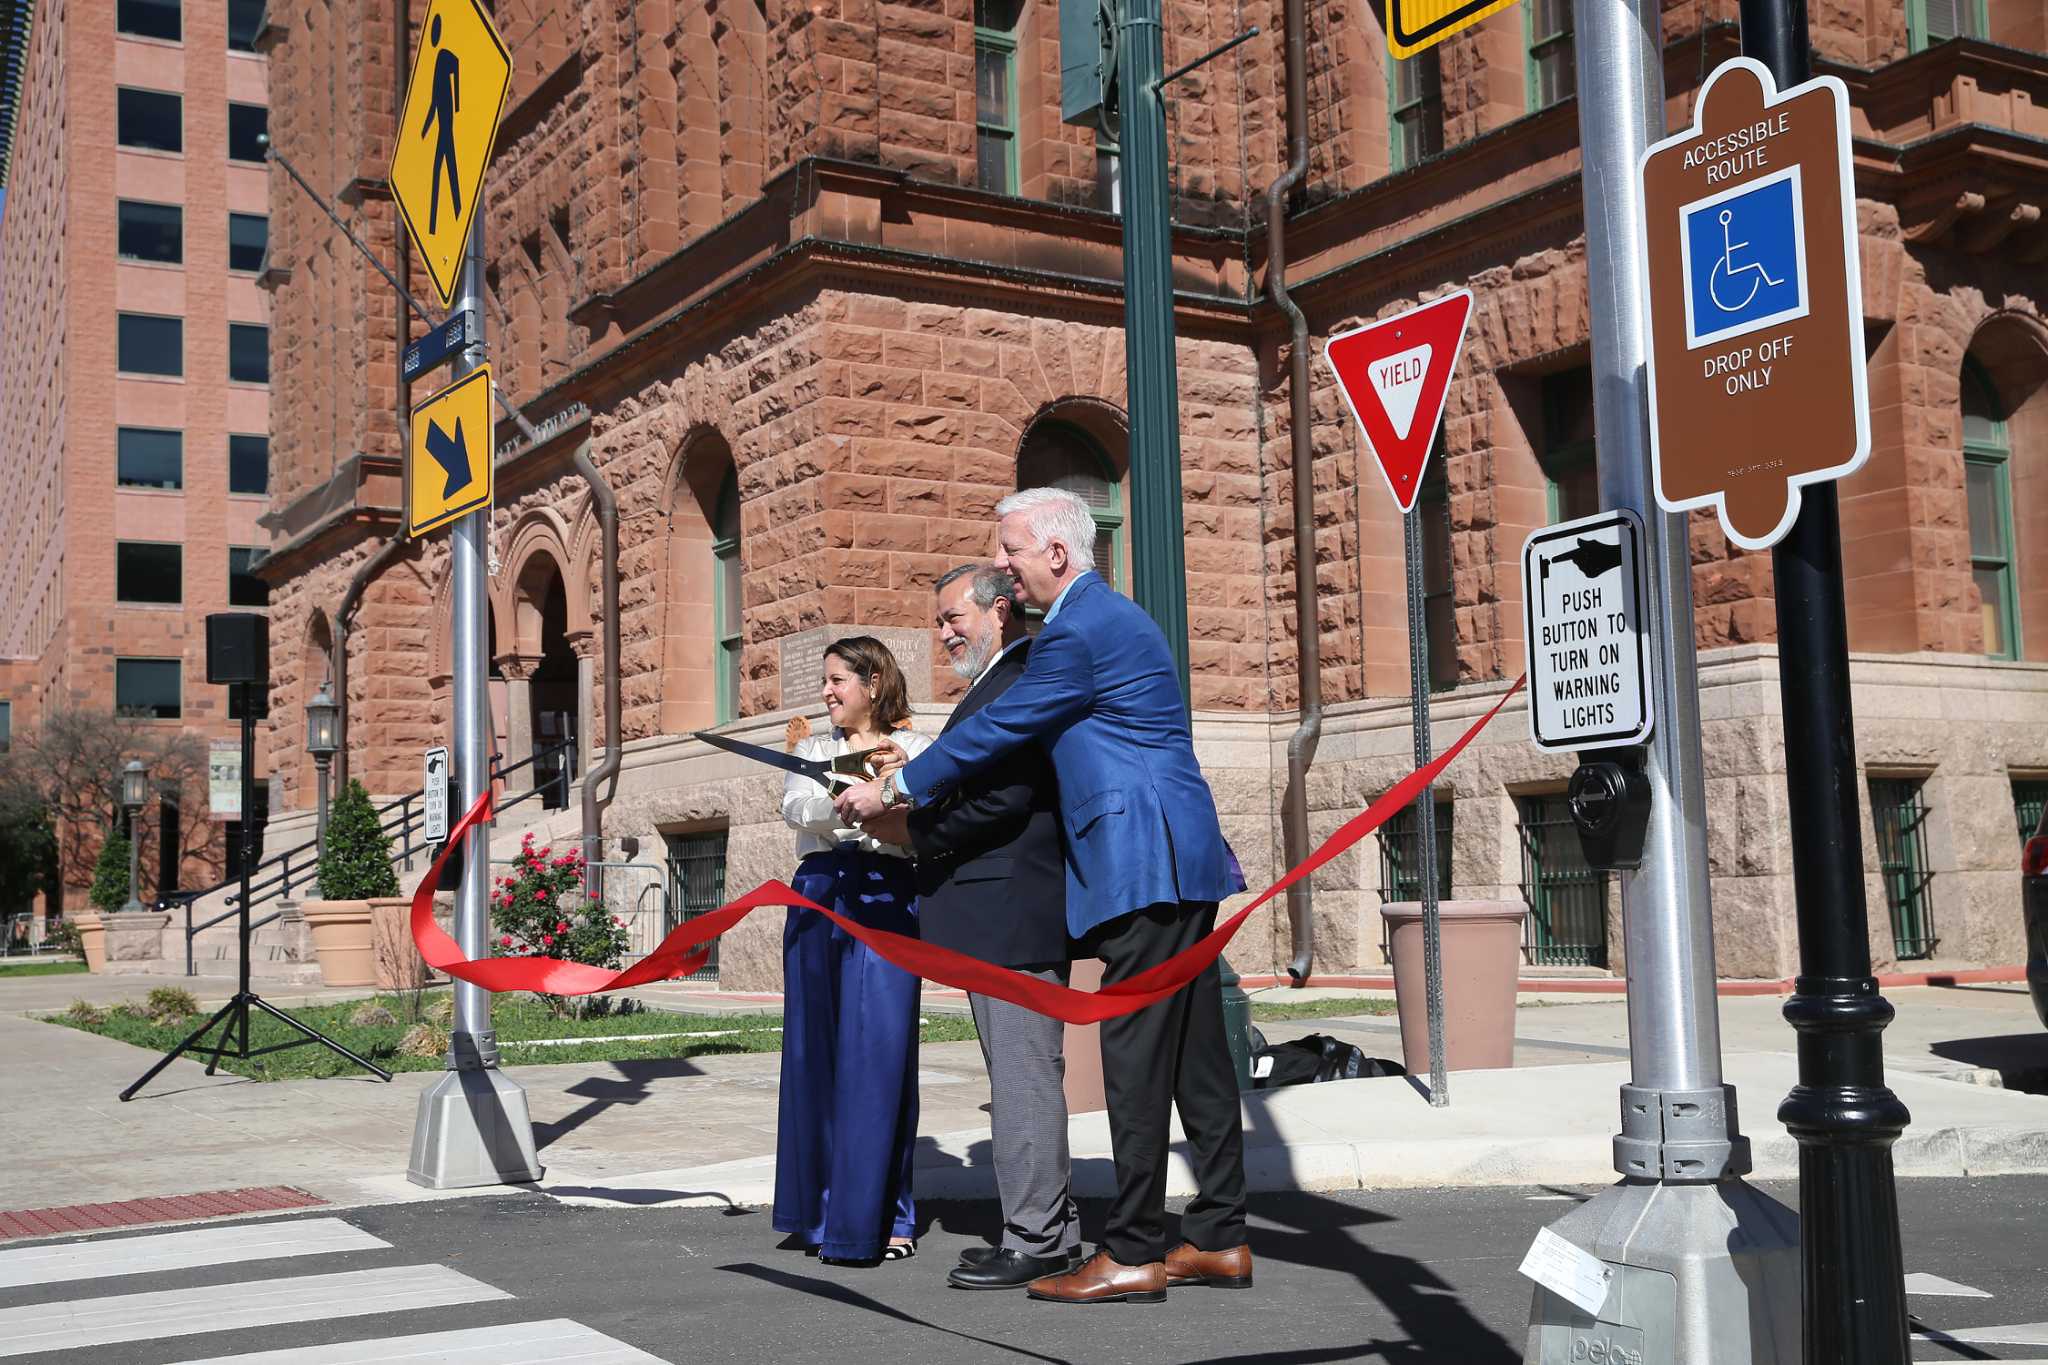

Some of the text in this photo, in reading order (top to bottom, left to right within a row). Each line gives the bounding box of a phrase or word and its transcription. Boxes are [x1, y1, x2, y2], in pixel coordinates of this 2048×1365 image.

[1683, 112, 1791, 170] ACCESSIBLE
[1707, 146, 1768, 185] ROUTE
[1704, 336, 1794, 378] DROP OFF
[1380, 357, 1421, 390] YIELD
[1726, 366, 1772, 395] ONLY
[1562, 587, 1602, 614] PUSH
[1542, 612, 1626, 646] BUTTON TO
[1550, 643, 1619, 673] TURN ON
[1553, 672, 1620, 701] WARNING
[1563, 703, 1614, 729] LIGHTS
